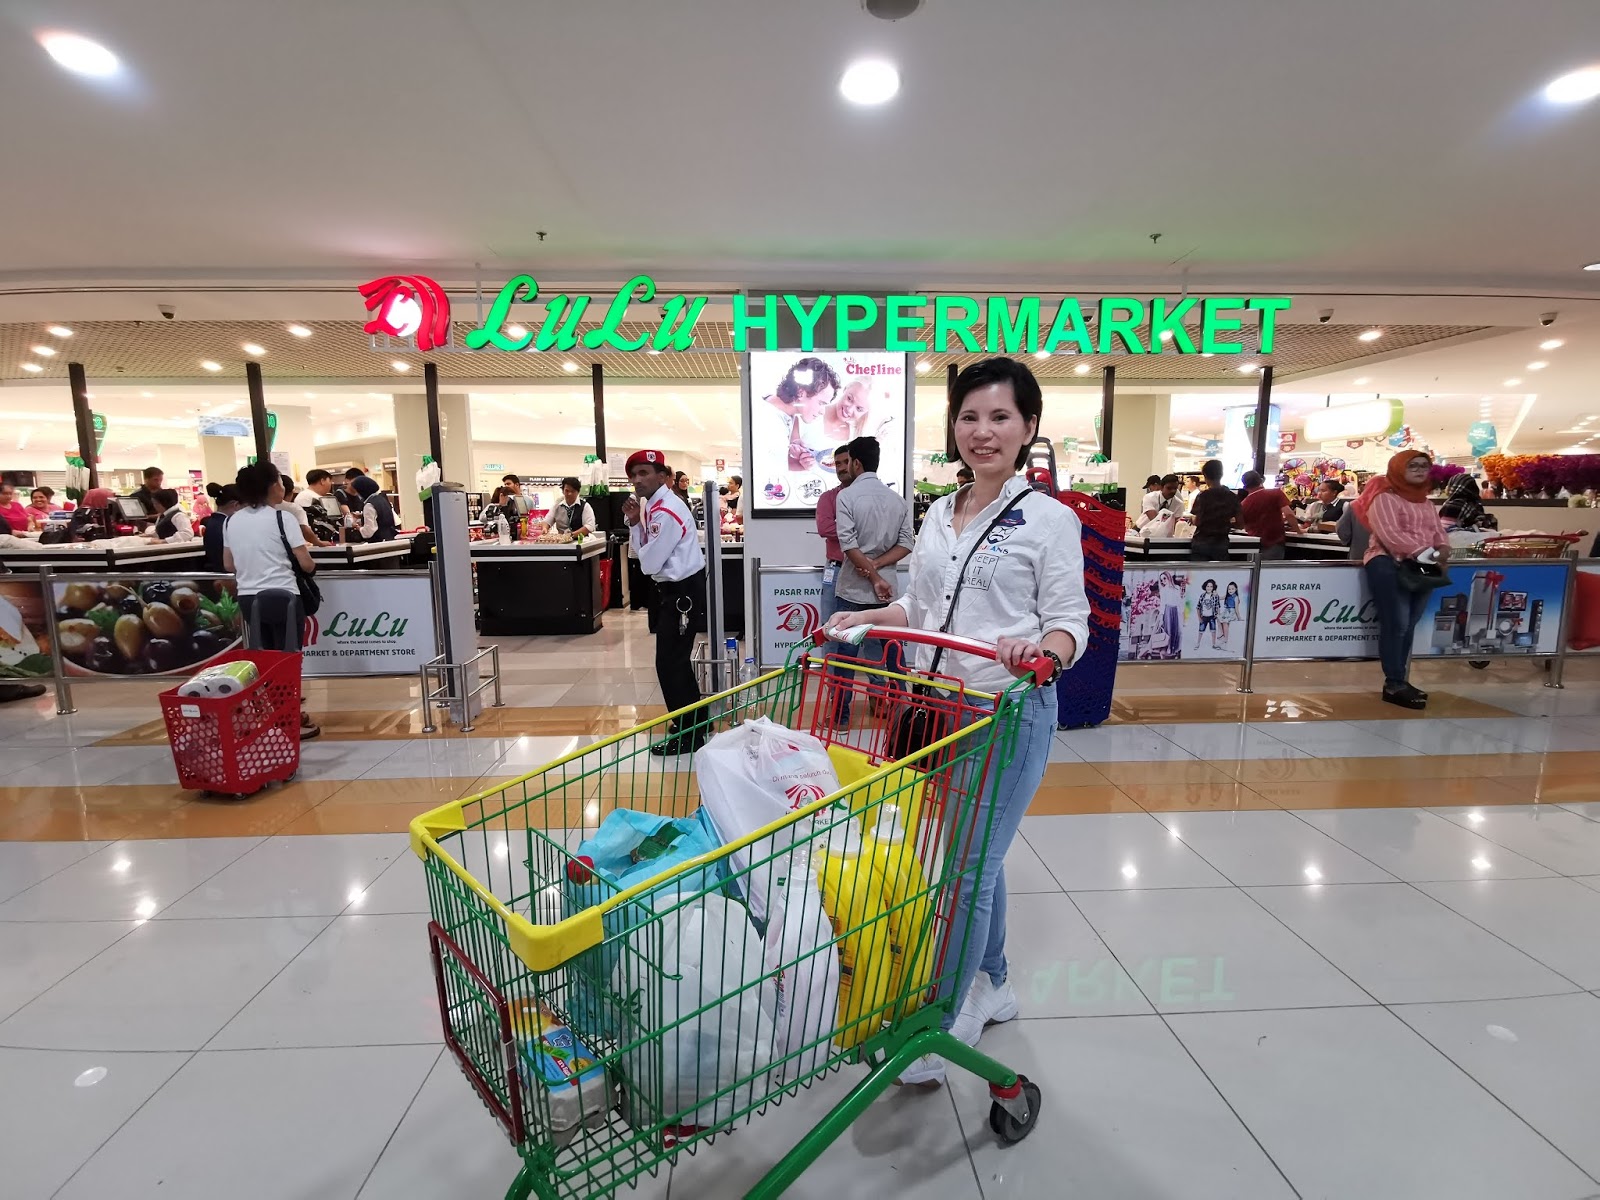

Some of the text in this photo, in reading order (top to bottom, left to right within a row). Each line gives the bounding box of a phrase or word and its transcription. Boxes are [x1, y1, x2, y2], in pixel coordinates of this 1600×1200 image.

[465, 274, 1293, 355] LuLu HYPERMARKET
[846, 364, 901, 375] Chefline
[973, 566, 983, 575] IT
[966, 577, 987, 587] REAL
[774, 588, 802, 596] PASAR
[1313, 599, 1380, 623] LuL
[322, 611, 408, 637] LuLu
[340, 648, 389, 656] DEPARTMENT
